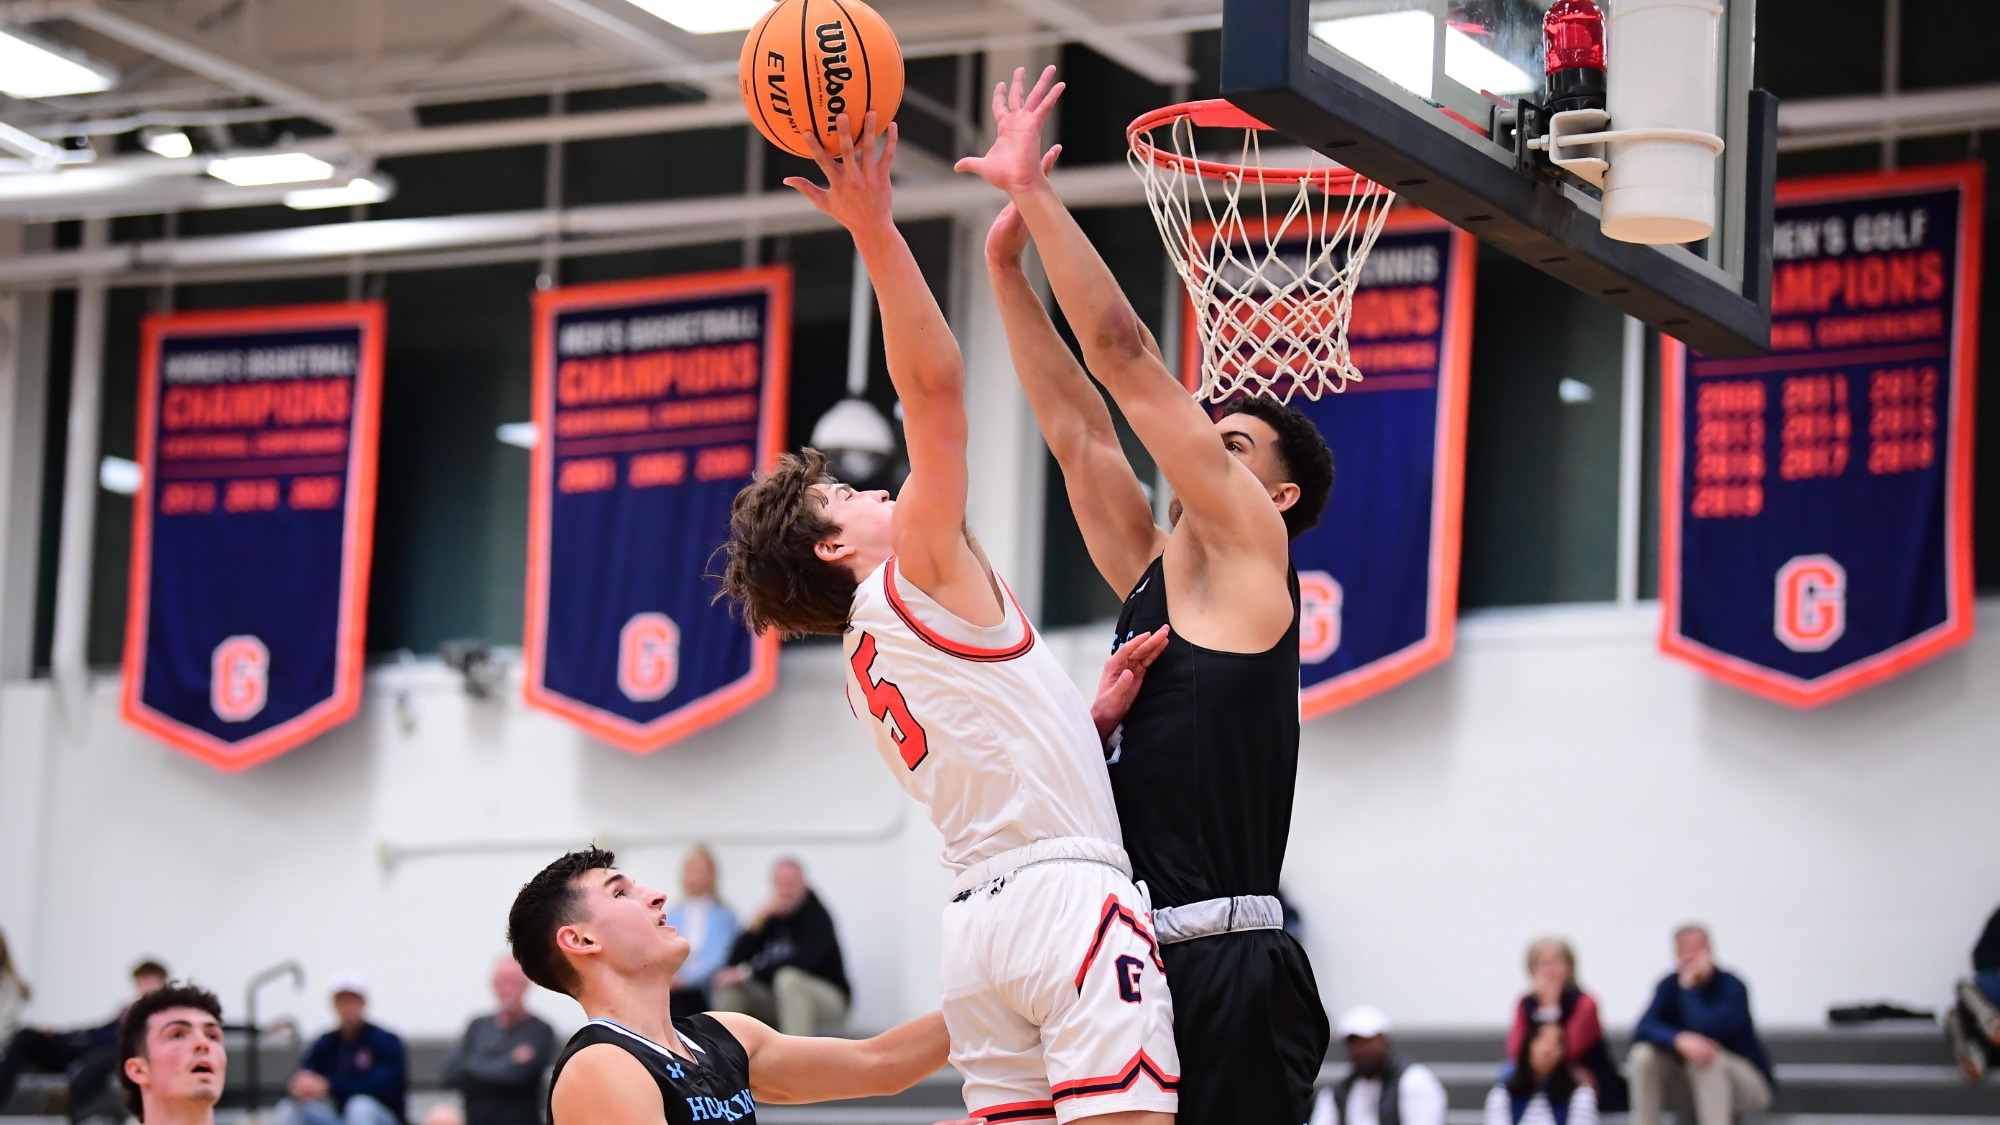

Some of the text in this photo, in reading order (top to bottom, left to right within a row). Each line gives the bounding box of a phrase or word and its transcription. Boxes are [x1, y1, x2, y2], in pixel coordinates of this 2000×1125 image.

[767, 50, 792, 117] EVO
[816, 20, 852, 133] Wilson
[1852, 208, 1928, 254] GOLF
[630, 307, 759, 351] BASKETBALL
[162, 376, 350, 431] CHAMPIONS
[558, 341, 759, 407] CHAMPIONS
[1773, 553, 1847, 653] G
[209, 634, 271, 723] G
[616, 611, 682, 703] G
[851, 630, 929, 772] 5
